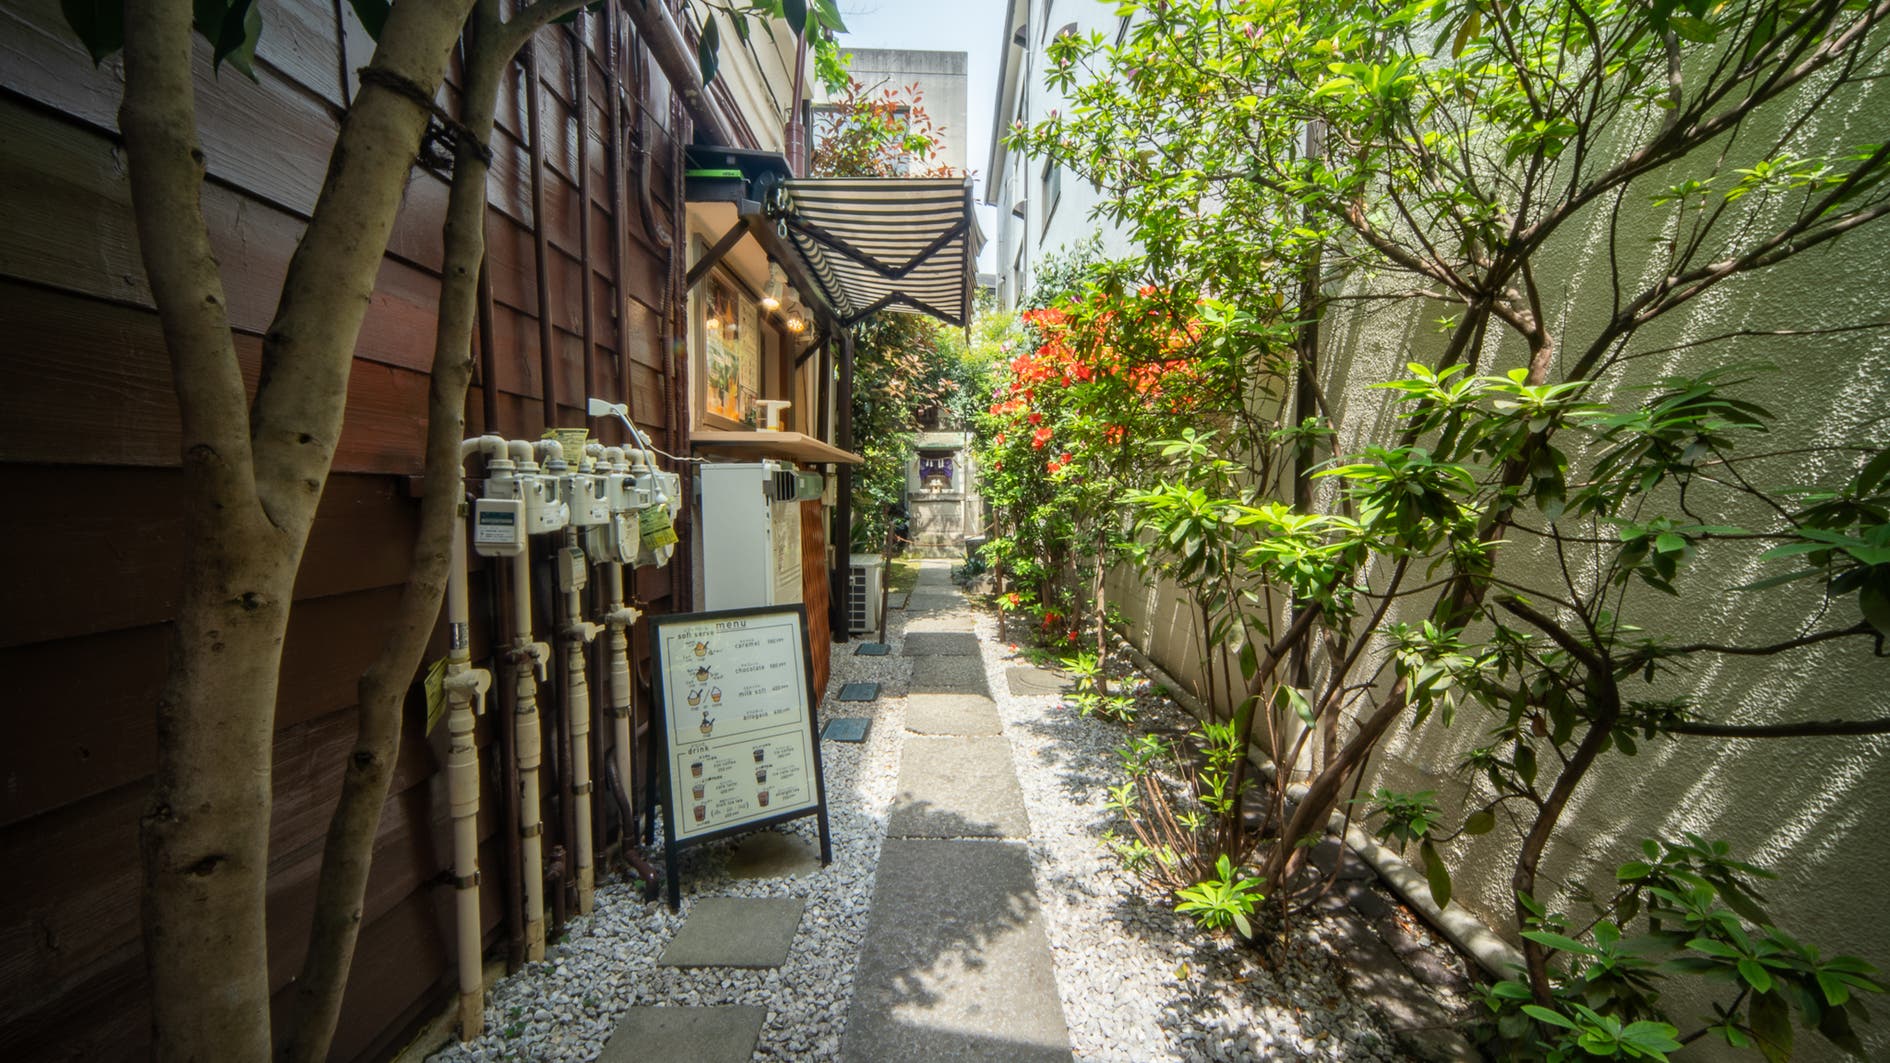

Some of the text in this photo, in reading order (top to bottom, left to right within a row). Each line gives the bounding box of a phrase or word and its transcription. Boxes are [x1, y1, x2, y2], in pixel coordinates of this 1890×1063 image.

[716, 620, 746, 629] menu
[734, 640, 760, 649] caramel
[735, 664, 765, 674] chocolate
[687, 745, 708, 755] drink
